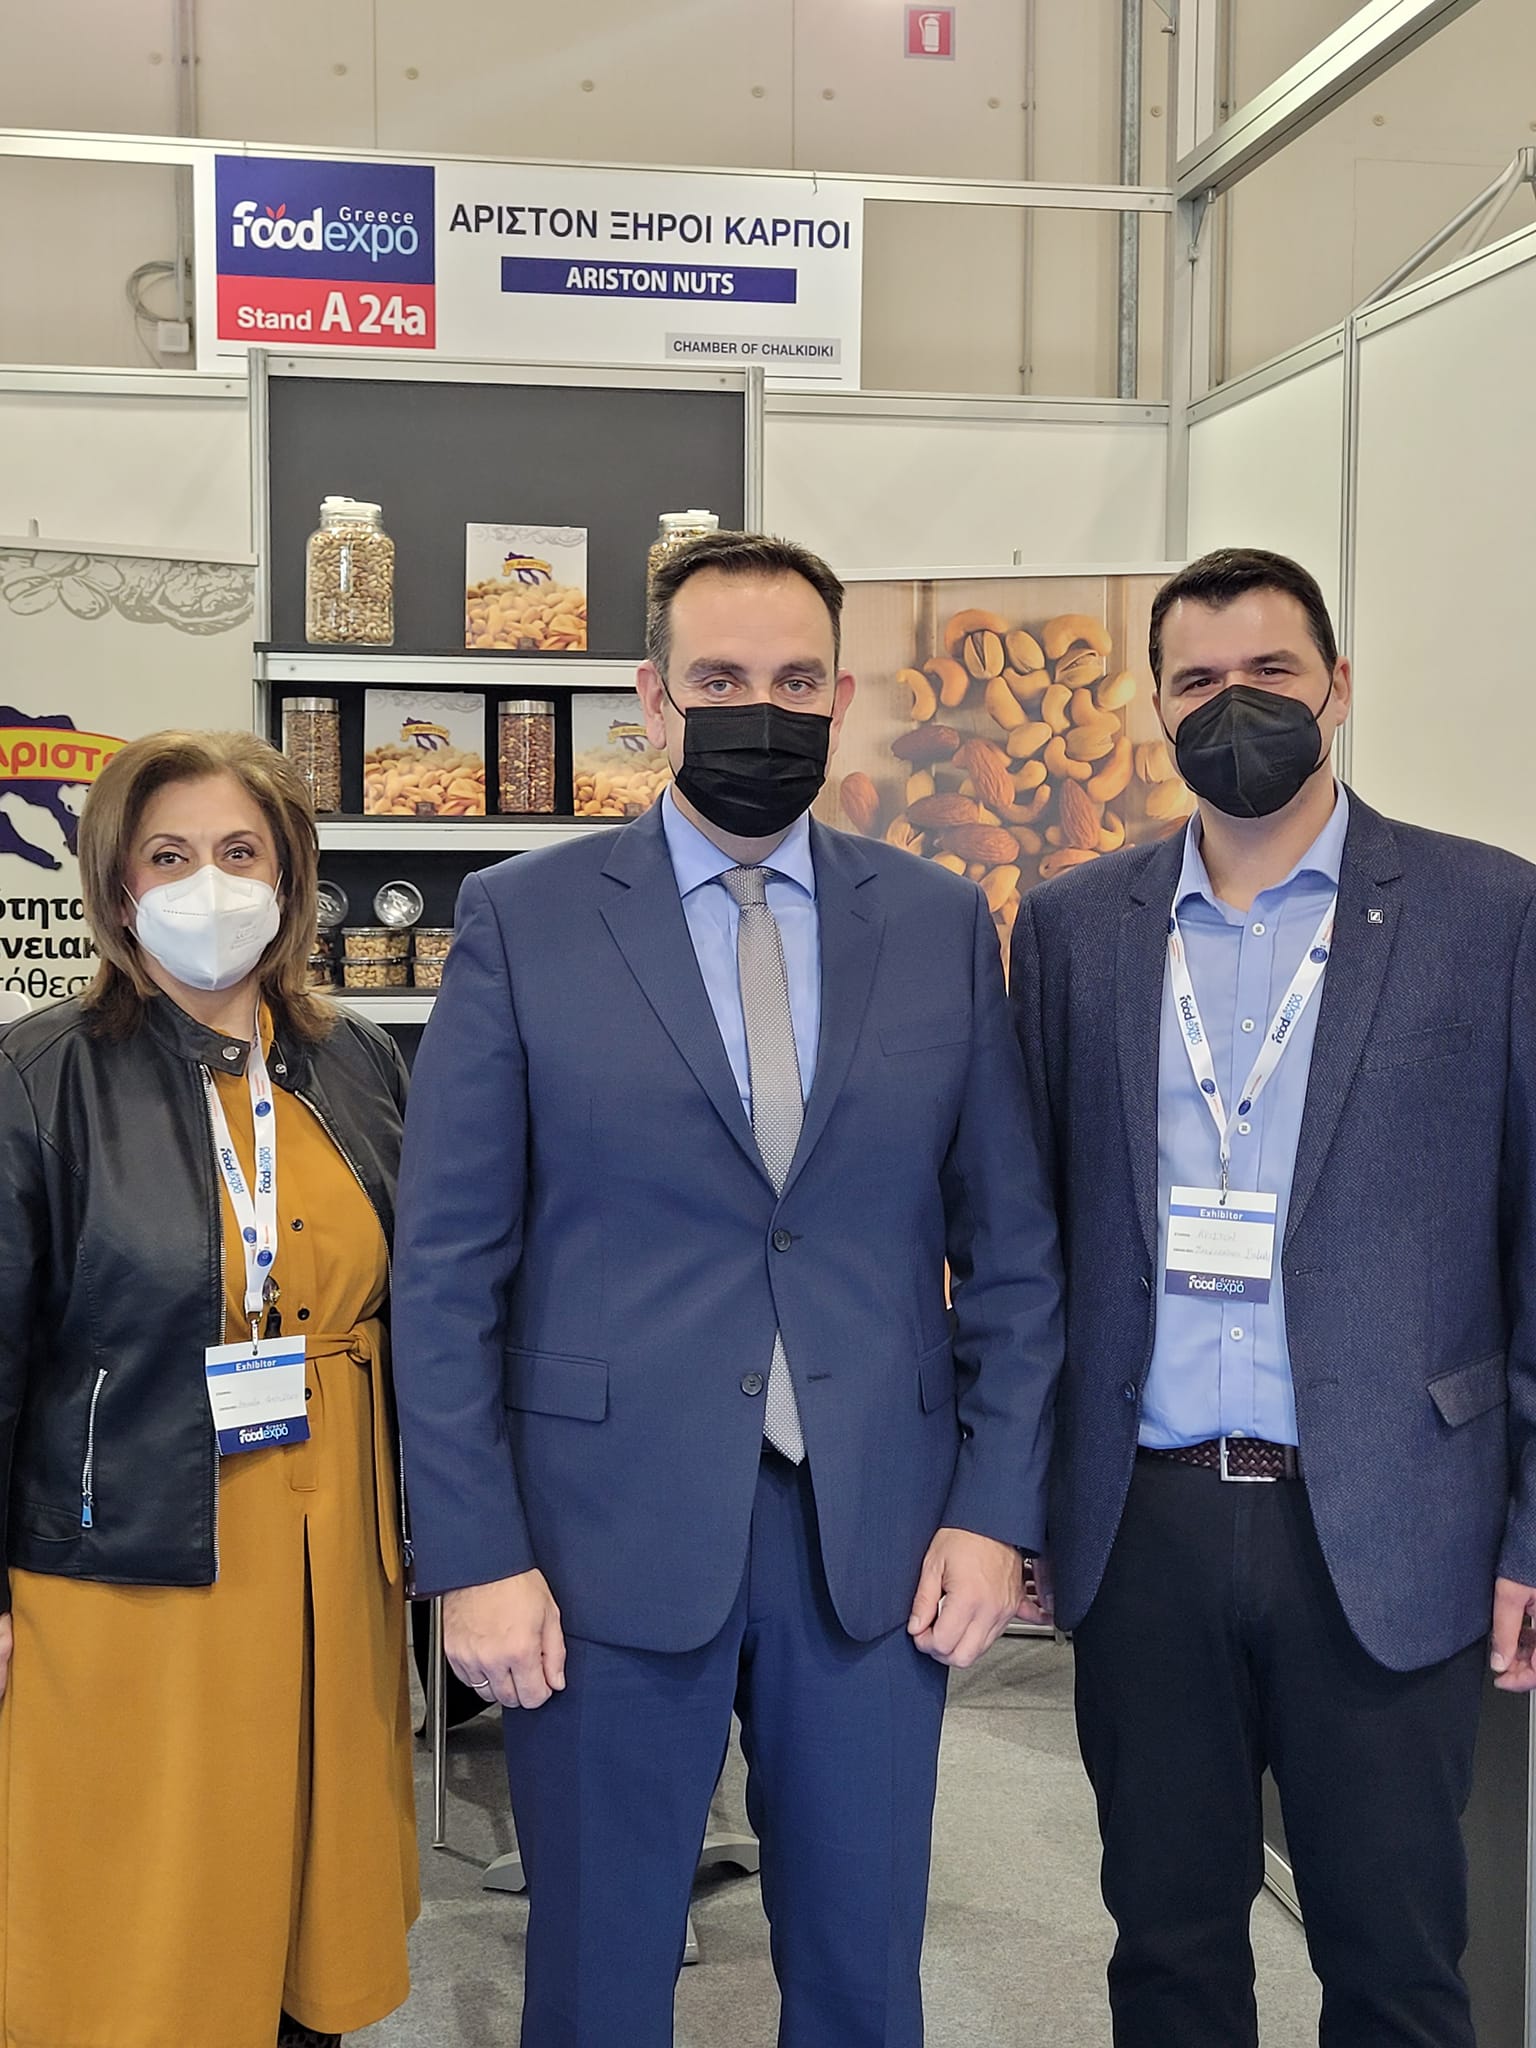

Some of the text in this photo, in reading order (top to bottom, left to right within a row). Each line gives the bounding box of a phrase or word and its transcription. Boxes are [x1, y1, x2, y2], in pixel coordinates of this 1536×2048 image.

[339, 206, 414, 225] Greece
[449, 203, 850, 249] ΑΡΙΣΤΟΝ ΞΗΡΟΙ ΚΑΡΠΟΙ
[231, 200, 419, 262] foodexpo
[566, 266, 734, 295] ARISTON NUTS
[236, 291, 427, 336] Stand A 24a
[673, 341, 834, 358] CHAMBER OF CHALKIDIKI
[1200, 1208, 1243, 1220] Exhibitor
[235, 1360, 277, 1371] Exhibitor
